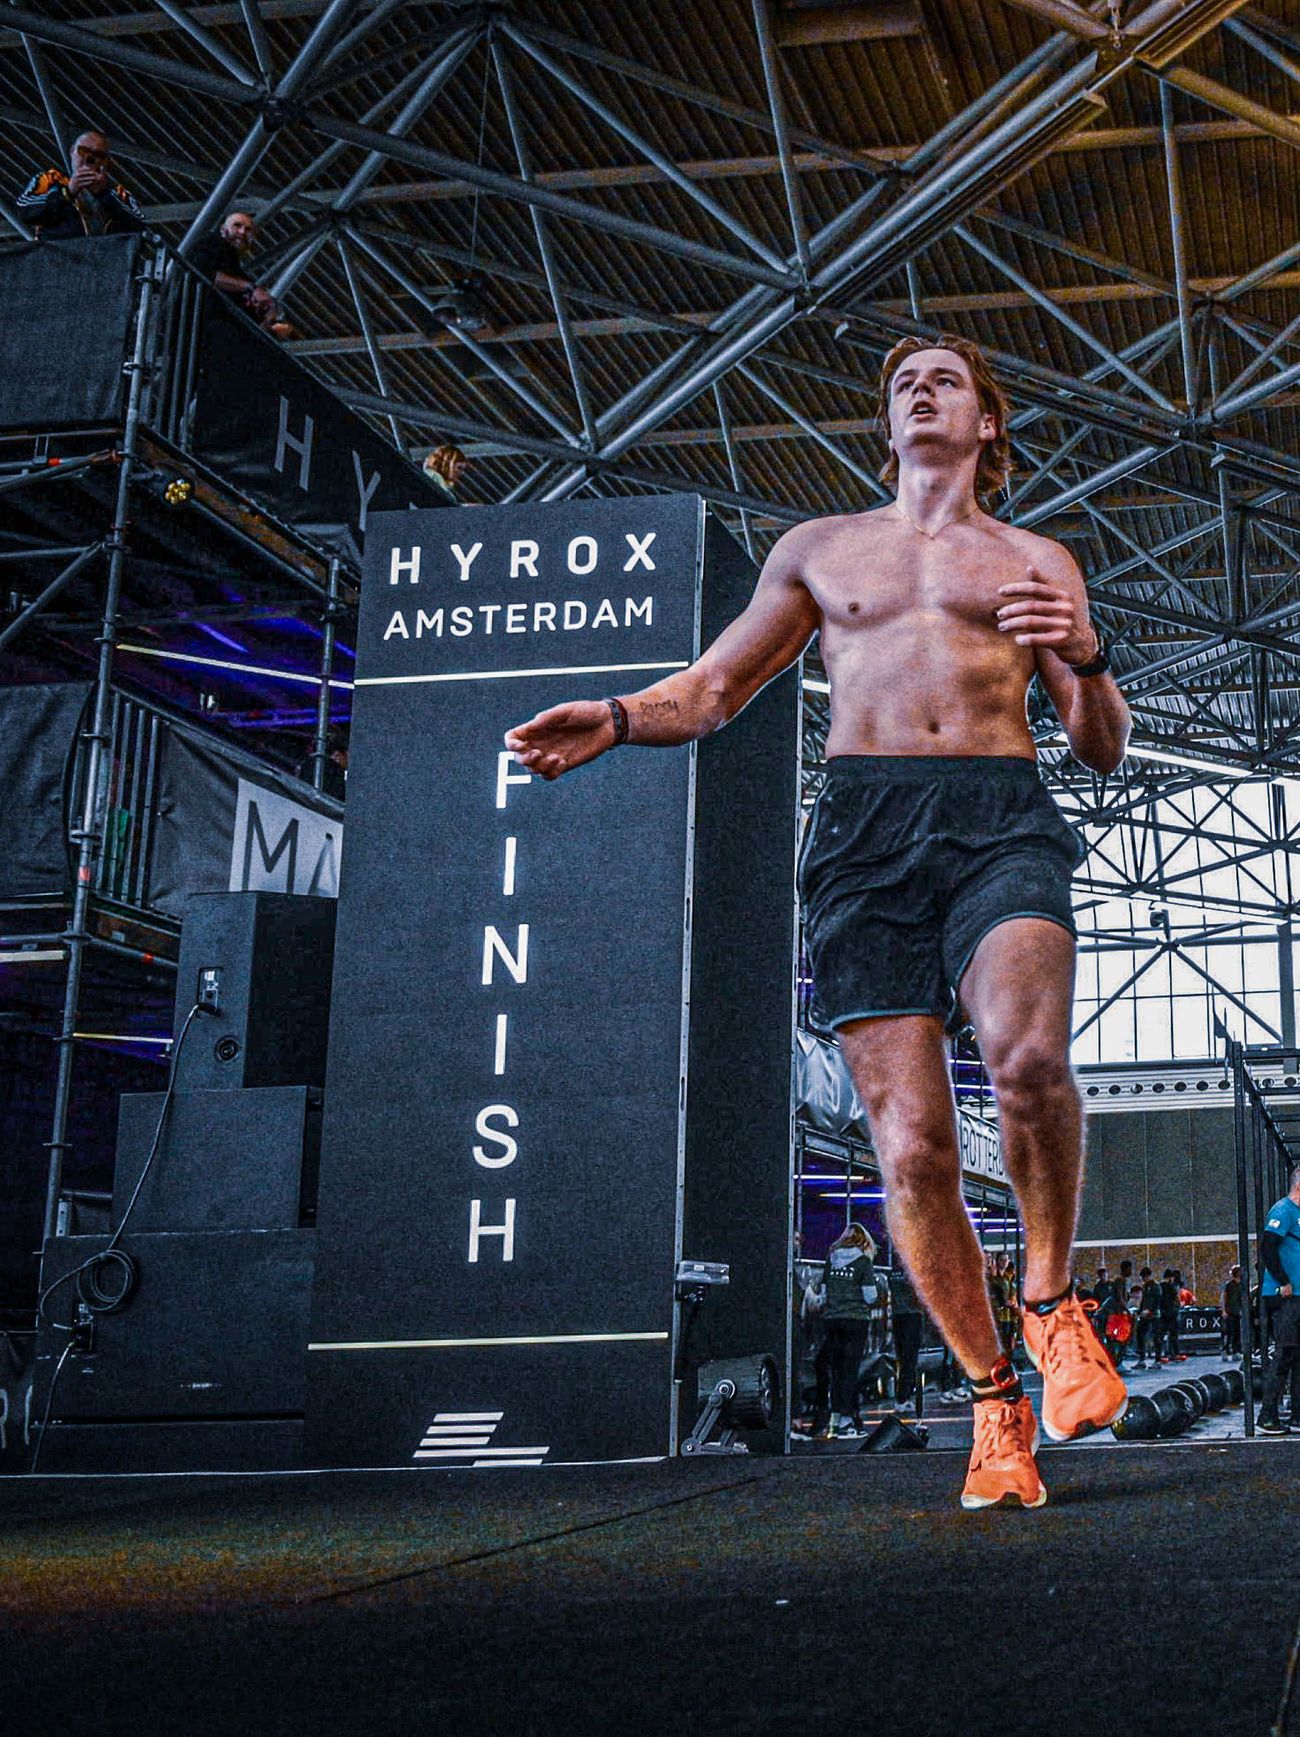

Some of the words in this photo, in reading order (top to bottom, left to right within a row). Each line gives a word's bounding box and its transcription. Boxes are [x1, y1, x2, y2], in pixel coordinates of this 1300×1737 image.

[274, 395, 418, 531] HY
[389, 533, 656, 585] HYROX
[383, 596, 653, 641] AMSTERDAM
[467, 750, 533, 1263] FINISH
[1186, 1317, 1221, 1329] ROX
